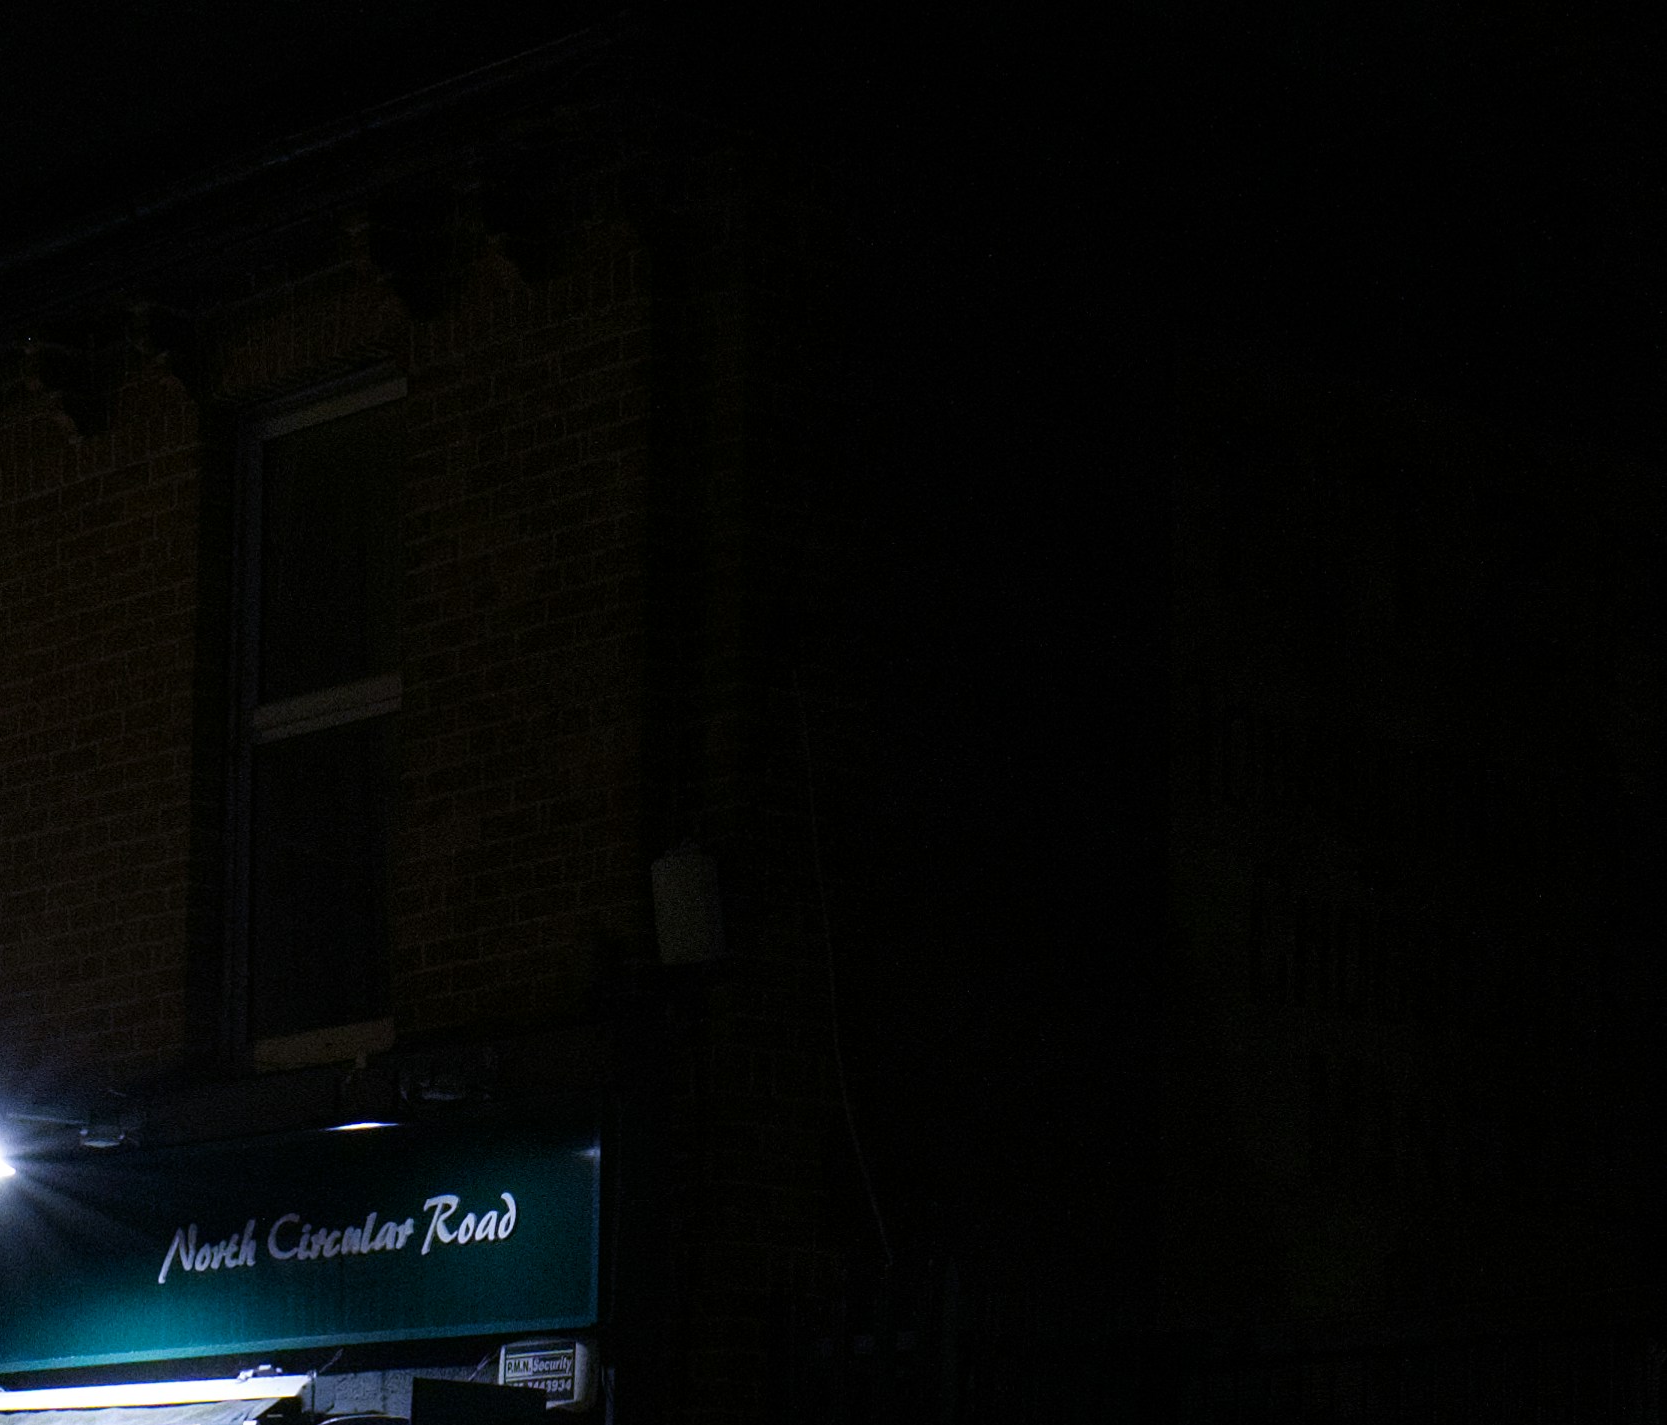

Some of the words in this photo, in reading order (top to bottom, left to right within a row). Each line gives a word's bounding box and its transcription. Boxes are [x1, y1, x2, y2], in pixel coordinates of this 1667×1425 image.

[157, 1217, 258, 1285] North
[266, 1211, 415, 1262] Circular
[420, 1191, 518, 1256] Road
[532, 1355, 573, 1375] Security
